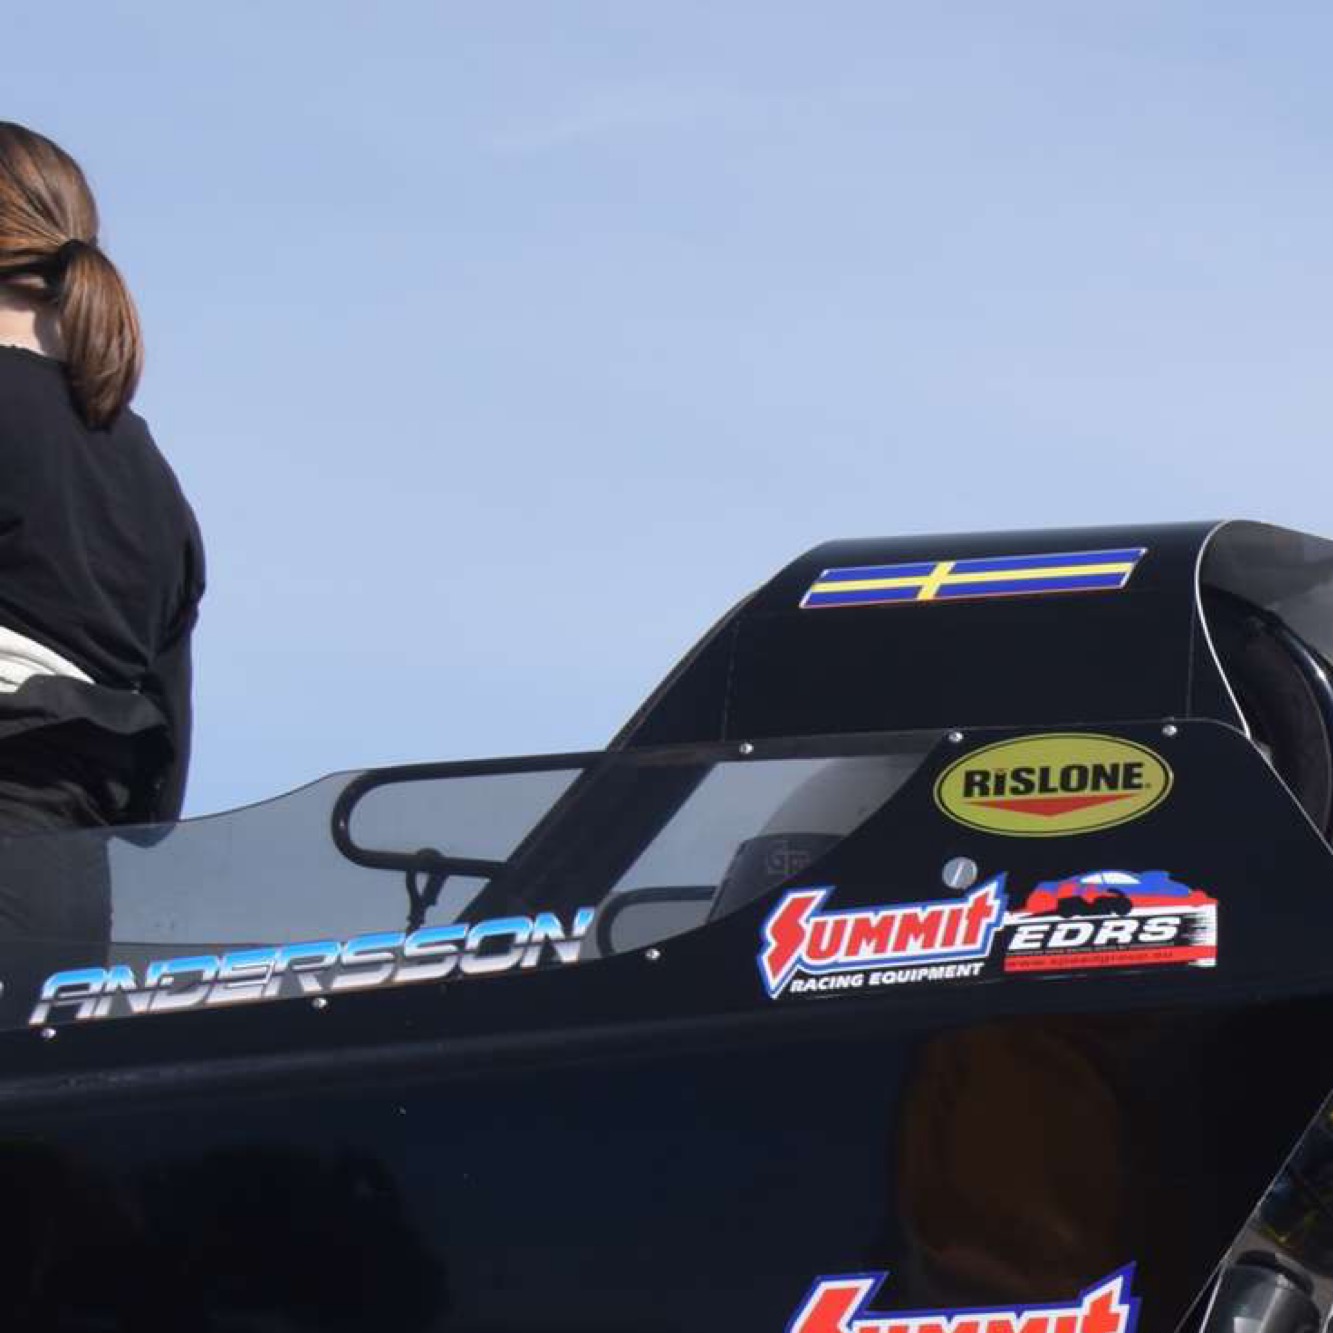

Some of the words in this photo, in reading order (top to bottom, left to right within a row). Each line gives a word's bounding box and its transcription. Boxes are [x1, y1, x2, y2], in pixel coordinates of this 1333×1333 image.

[1008, 916, 1182, 951] EDRS
[28, 908, 595, 1026] ANDERSSON
[790, 972, 863, 993] RACING
[868, 962, 985, 986] EQUIPMENT
